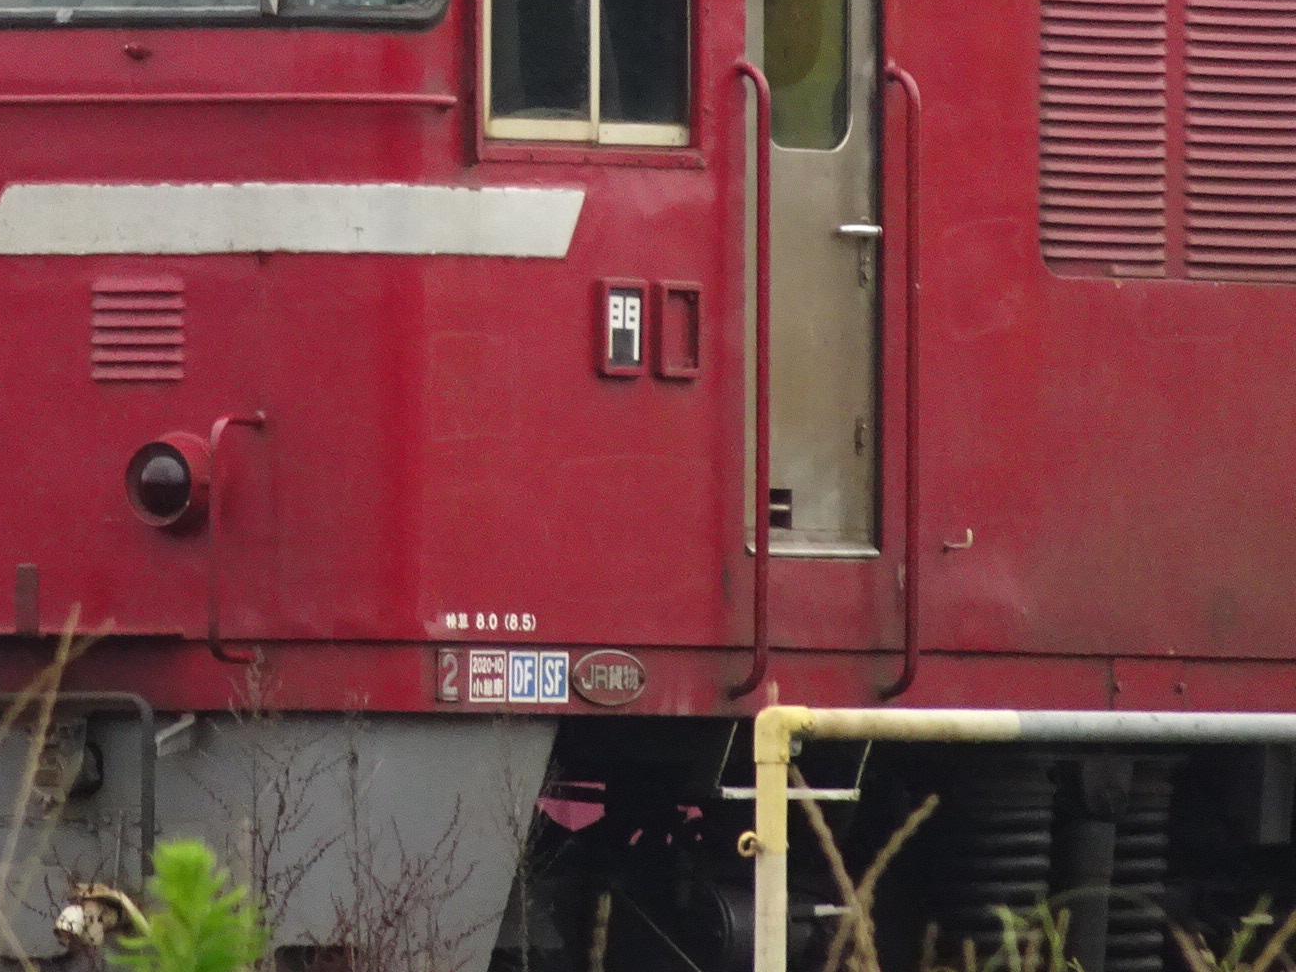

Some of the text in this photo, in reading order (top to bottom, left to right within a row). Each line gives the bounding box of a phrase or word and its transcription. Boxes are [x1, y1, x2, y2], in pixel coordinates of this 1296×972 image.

[475, 612, 498, 630] 8.0
[504, 613, 537, 632] (8.5)
[441, 653, 459, 695] 2
[513, 658, 534, 695] DF
[543, 658, 565, 696] SF
[580, 664, 640, 691] JR貨物
